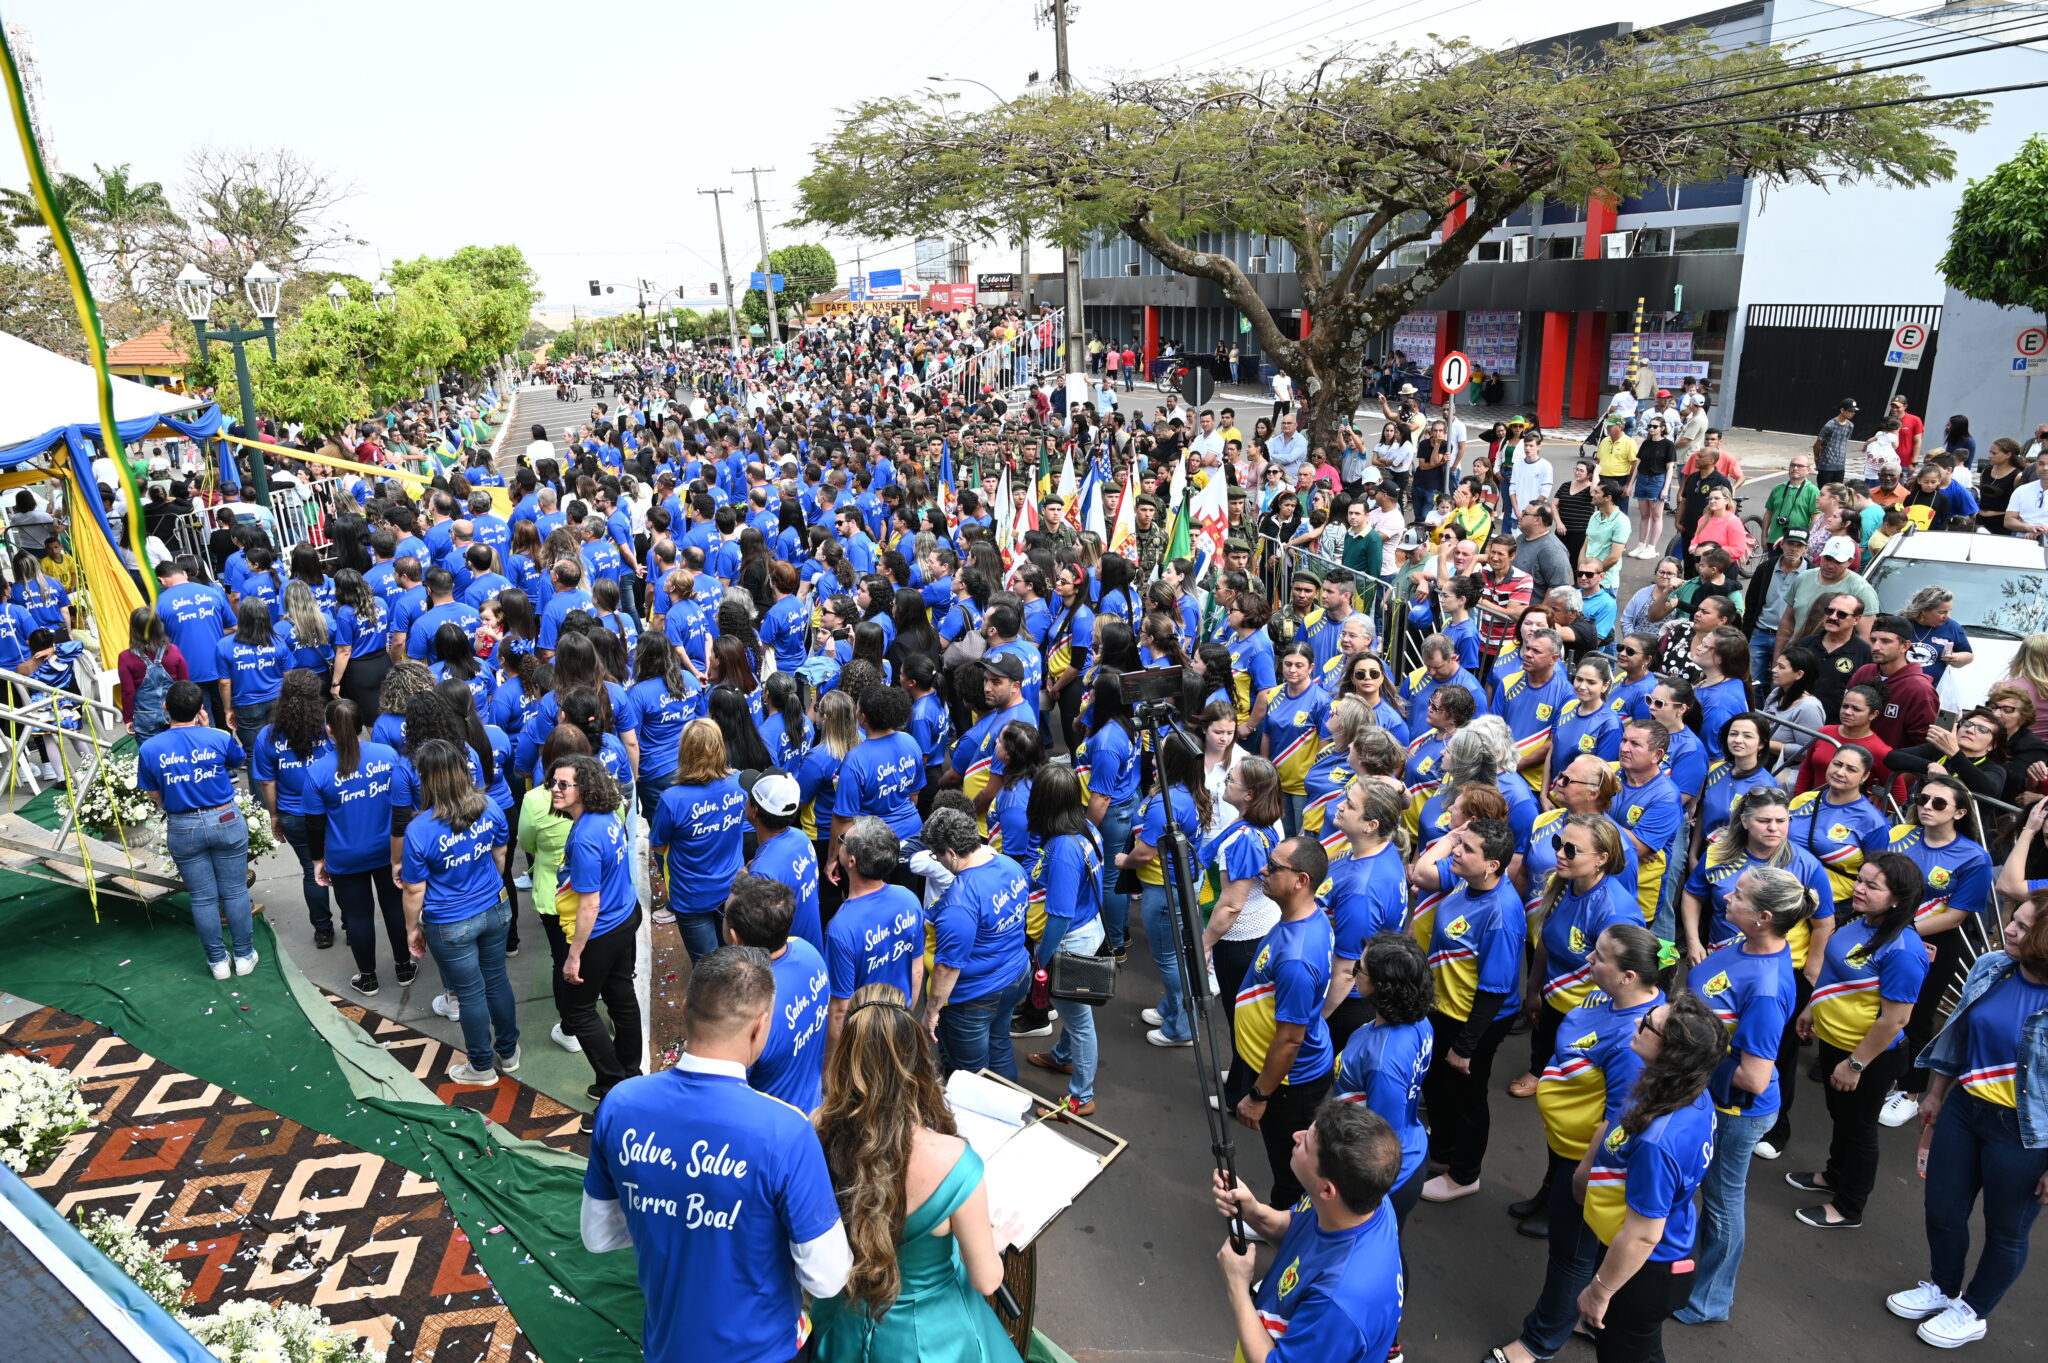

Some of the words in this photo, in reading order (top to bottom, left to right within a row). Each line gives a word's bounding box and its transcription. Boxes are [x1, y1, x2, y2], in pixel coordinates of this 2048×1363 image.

[980, 274, 1010, 284] Estoril
[852, 303, 869, 311] SL
[872, 302, 917, 310] NASCENTE
[1903, 330, 1916, 345] E
[2024, 334, 2038, 351] E
[172, 596, 194, 610] Salve,
[194, 594, 214, 608] Salve
[176, 610, 198, 622] Terra
[198, 606, 215, 620] Boa!
[234, 646, 255, 658] Salve,
[256, 644, 276, 656] Salve
[236, 660, 257, 672] Terra
[159, 751, 188, 769] Salve,
[191, 748, 217, 765] Salve
[366, 760, 392, 777] Salve
[164, 771, 190, 786] Terra
[194, 765, 218, 784] Boa!
[338, 789, 366, 804] Terra
[369, 777, 392, 798] Boa!
[691, 798, 720, 820] Salve,
[722, 791, 744, 810] Salve
[692, 820, 720, 838] Terra
[722, 810, 744, 832] Boa!
[439, 832, 467, 852] Salve,
[470, 818, 494, 839] Salve
[443, 852, 471, 870] Terra
[474, 836, 494, 860] Boa!
[865, 924, 890, 952] Salve,
[894, 910, 916, 936] Salve
[866, 953, 890, 974] Terra
[786, 996, 810, 1030] Salve,
[793, 1026, 814, 1056] Terra
[619, 1128, 678, 1171] Salve,
[685, 1139, 748, 1179] Salve
[622, 1180, 678, 1218] Terra
[686, 1192, 742, 1231] Boa!
